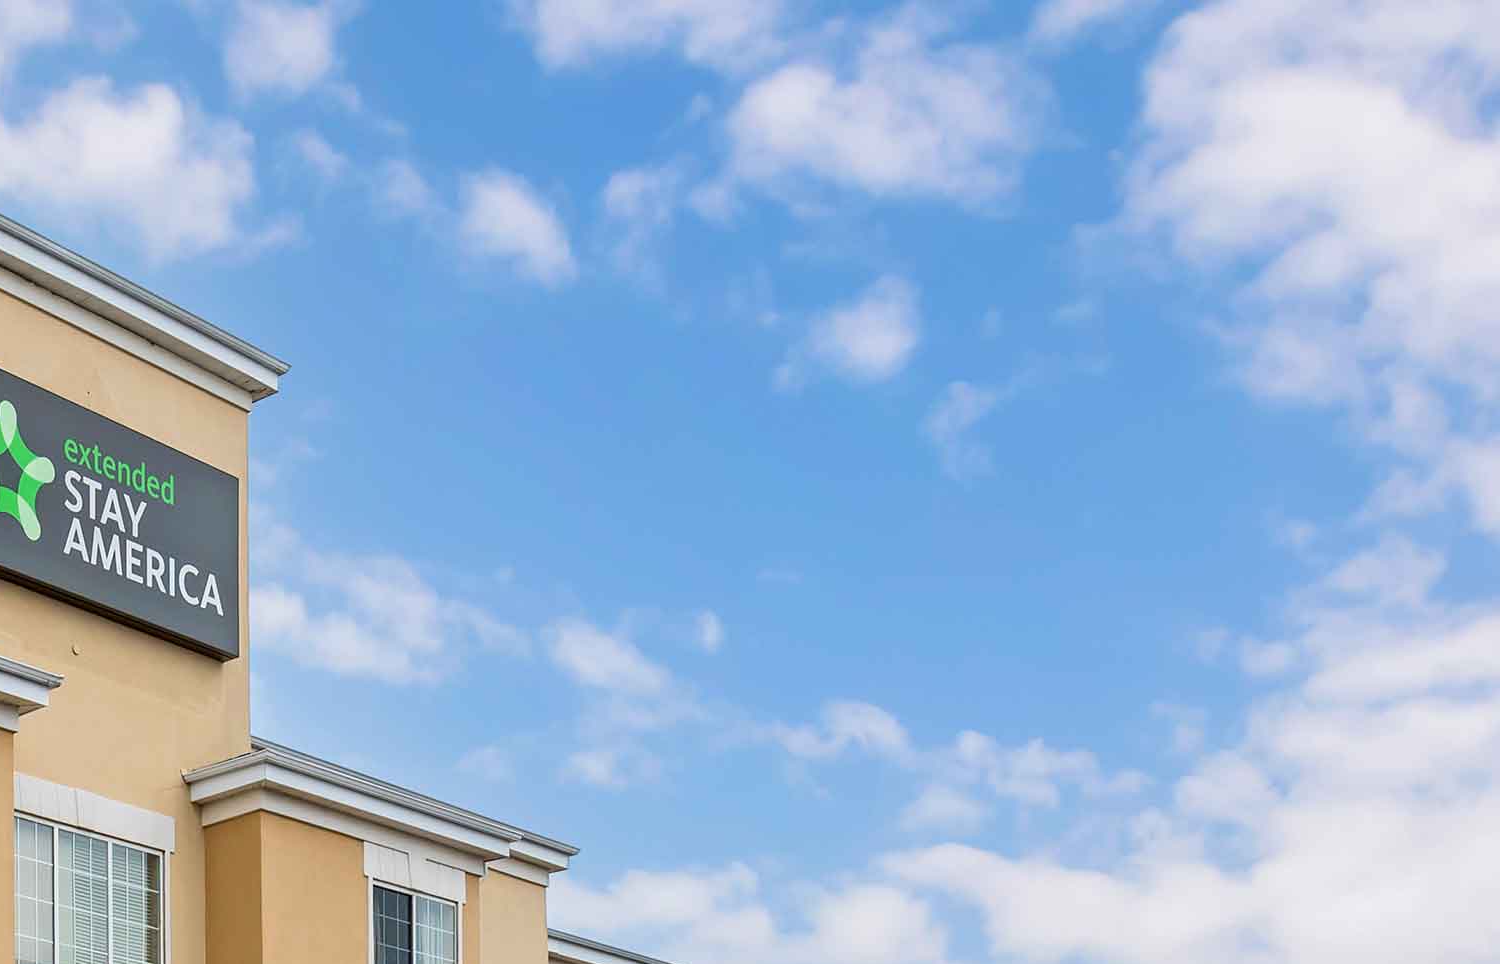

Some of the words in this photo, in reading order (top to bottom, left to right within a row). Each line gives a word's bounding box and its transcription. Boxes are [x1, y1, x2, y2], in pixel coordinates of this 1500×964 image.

[63, 438, 174, 505] extended
[64, 470, 147, 538] STAY
[63, 518, 224, 616] AMERICA
